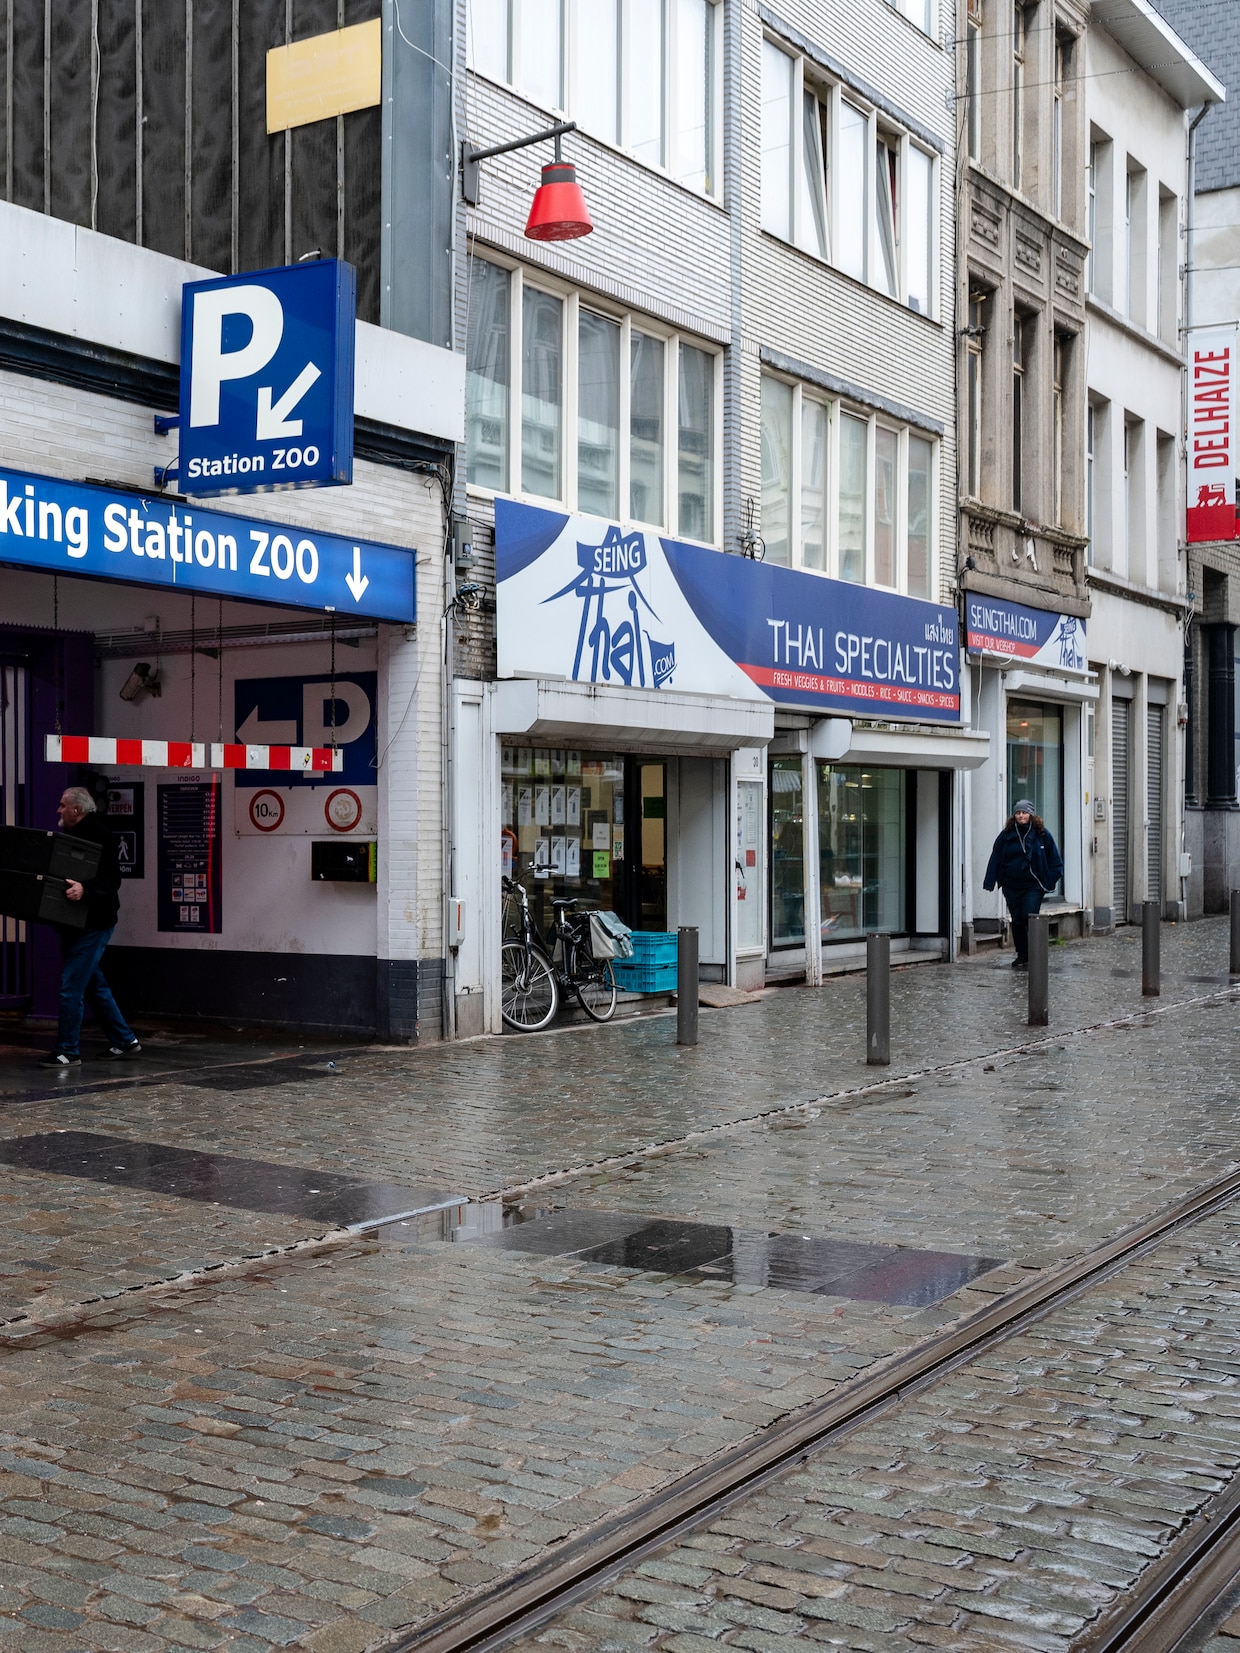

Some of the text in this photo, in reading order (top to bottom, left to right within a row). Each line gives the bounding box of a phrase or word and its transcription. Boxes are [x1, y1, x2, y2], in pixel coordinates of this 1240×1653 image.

[190, 285, 284, 428] P
[1194, 347, 1229, 469] DELHAIZE
[187, 446, 320, 479] Station ZOO
[103, 502, 239, 573] Station
[249, 530, 319, 585] ZOO
[593, 540, 641, 573] SEING
[766, 617, 955, 690] THAI SPECIALTIES
[971, 605, 1037, 641] SEINGTHAI.COM
[773, 672, 793, 687] FRESH
[794, 675, 818, 690] VEGGIES
[826, 681, 845, 694] FRUITS
[851, 685, 875, 698] NOODLES
[880, 687, 891, 700] RICE
[897, 689, 912, 703] SAUCE
[917, 692, 935, 706] SNACKS
[939, 695, 955, 708] SPICES
[303, 681, 371, 778] P
